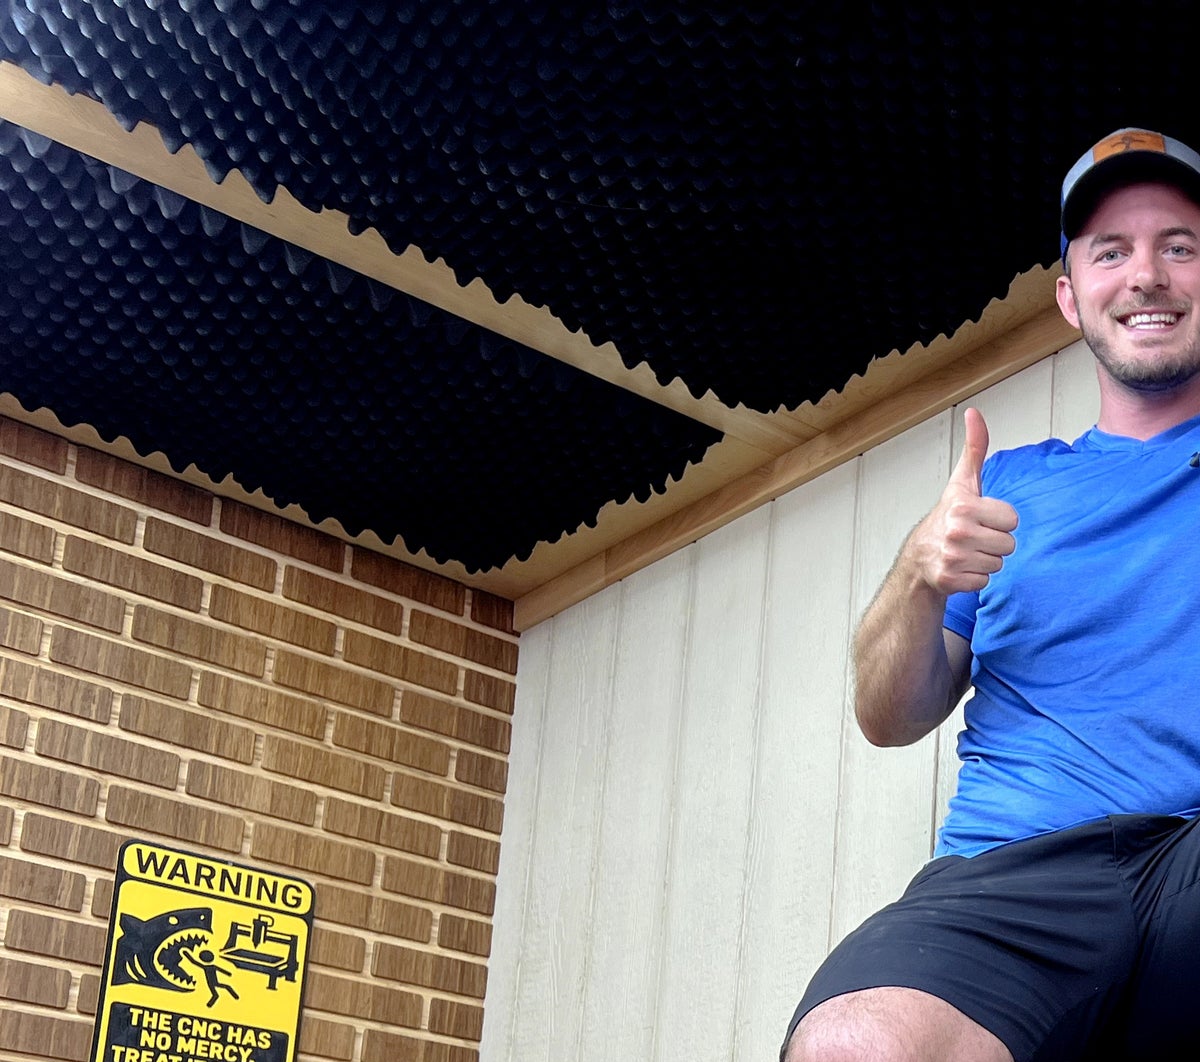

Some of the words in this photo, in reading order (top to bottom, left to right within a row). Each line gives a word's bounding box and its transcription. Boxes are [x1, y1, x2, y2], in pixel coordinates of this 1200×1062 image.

[136, 848, 303, 909] WARNING
[129, 1007, 172, 1032] THE
[177, 1017, 222, 1041] CNC
[227, 1026, 272, 1048] HAS
[140, 1030, 172, 1051] NO
